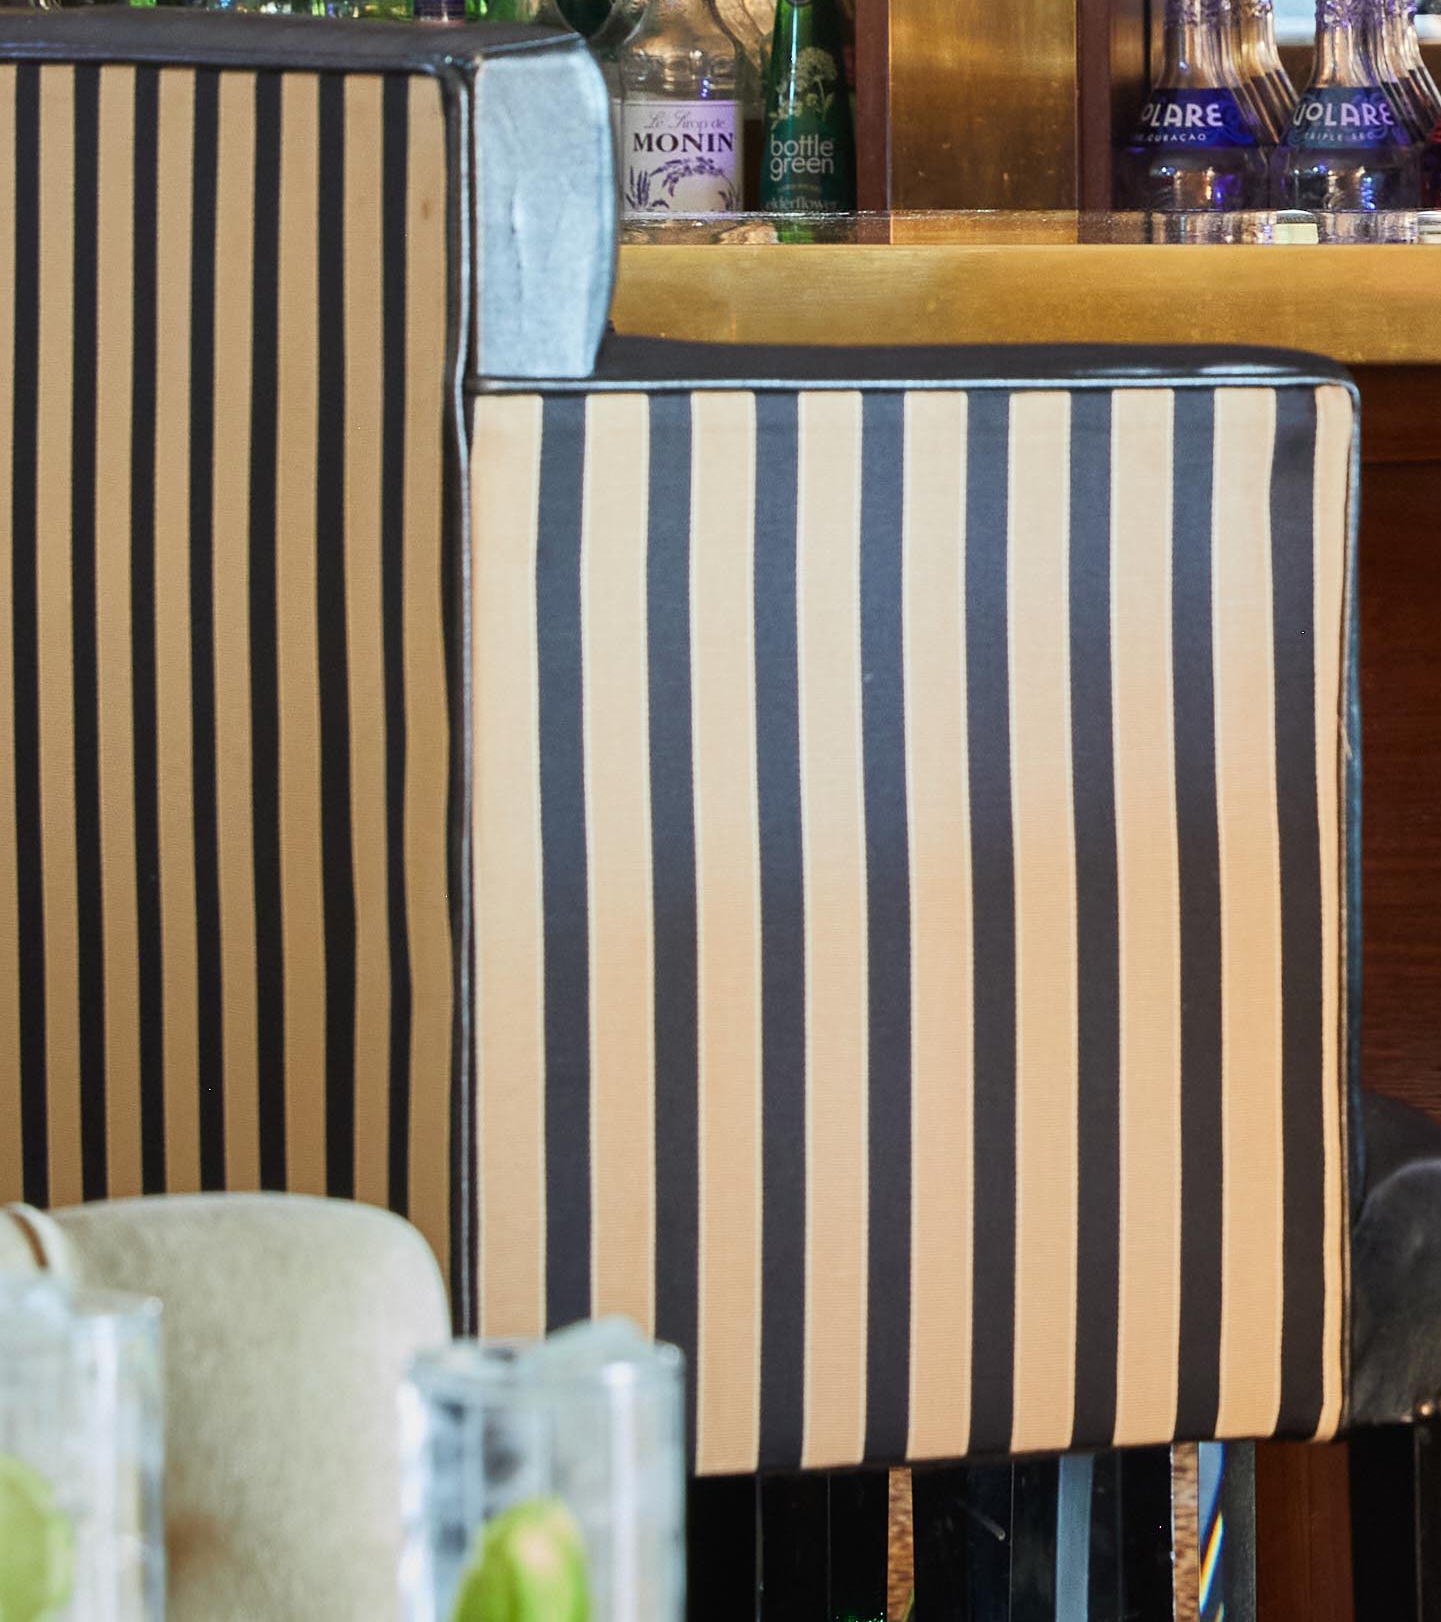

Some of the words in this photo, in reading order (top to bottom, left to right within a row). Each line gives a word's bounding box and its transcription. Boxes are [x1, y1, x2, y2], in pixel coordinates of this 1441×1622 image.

[710, 116, 727, 129] de
[1142, 102, 1224, 129] OLARE
[633, 132, 735, 153] MONIN
[769, 133, 836, 158] bottle
[769, 157, 835, 183] green
